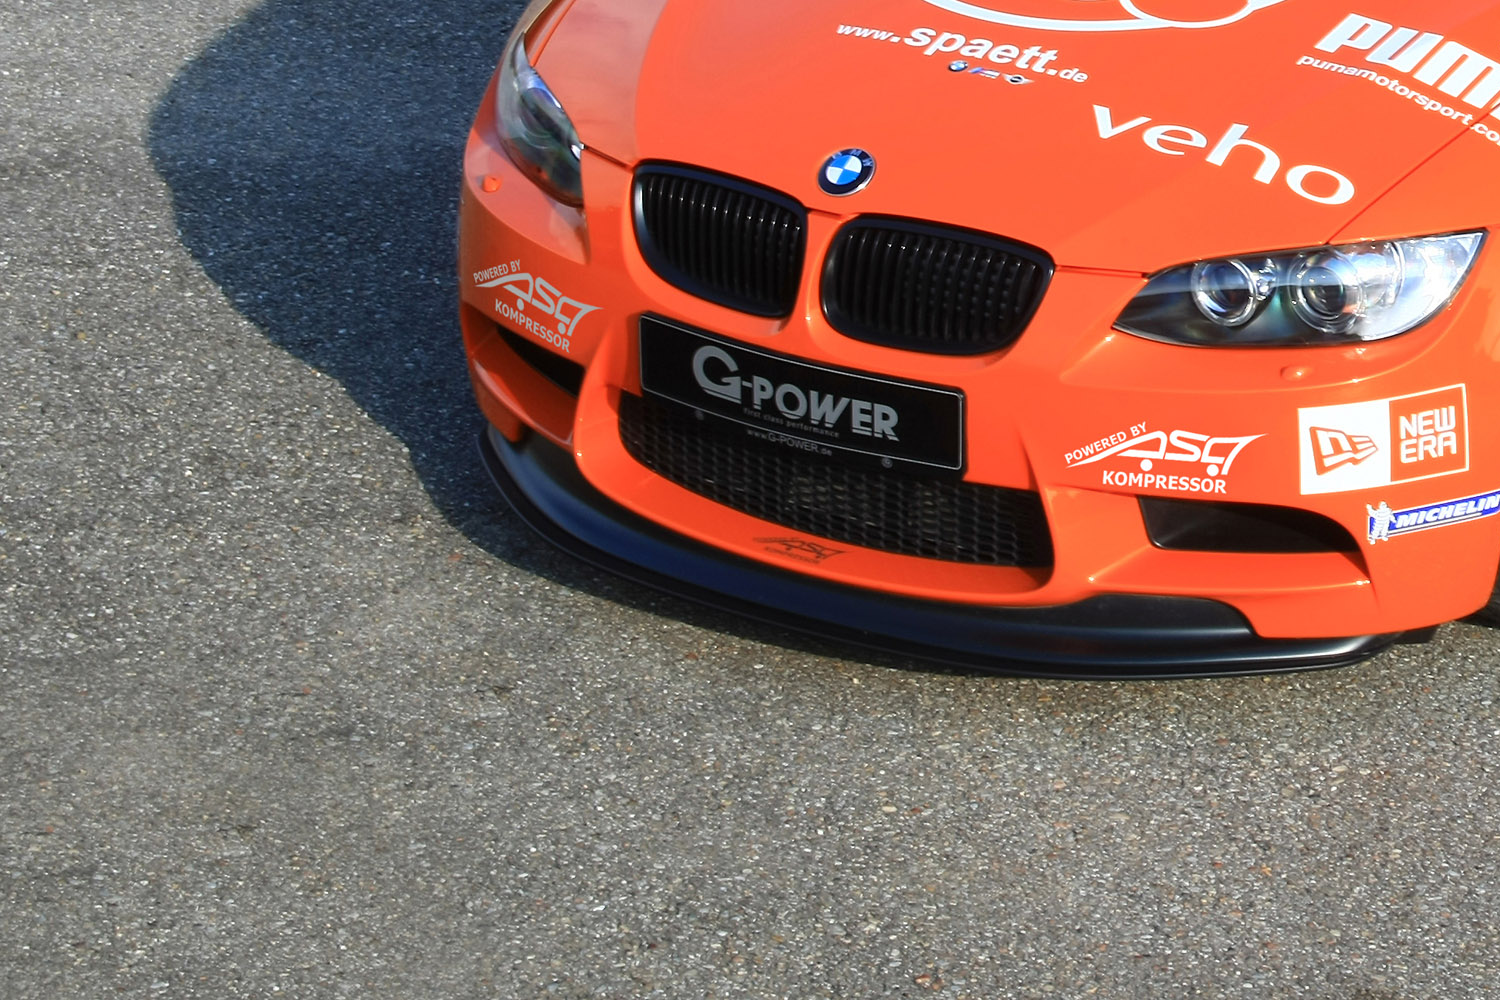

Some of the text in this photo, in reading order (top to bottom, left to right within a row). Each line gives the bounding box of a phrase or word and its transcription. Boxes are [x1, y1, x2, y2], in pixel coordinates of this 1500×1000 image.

[836, 23, 1088, 83] www.spaett.de
[1092, 104, 1355, 205] veho
[473, 259, 521, 283] POWERED BY
[495, 299, 570, 353] KOMPRESSOR
[692, 345, 899, 441] G-POWER
[1064, 421, 1147, 464] POWERED BY
[1400, 406, 1456, 439] NEW
[1400, 431, 1457, 463] ERA
[1102, 470, 1227, 494] KOMPRESSOR
